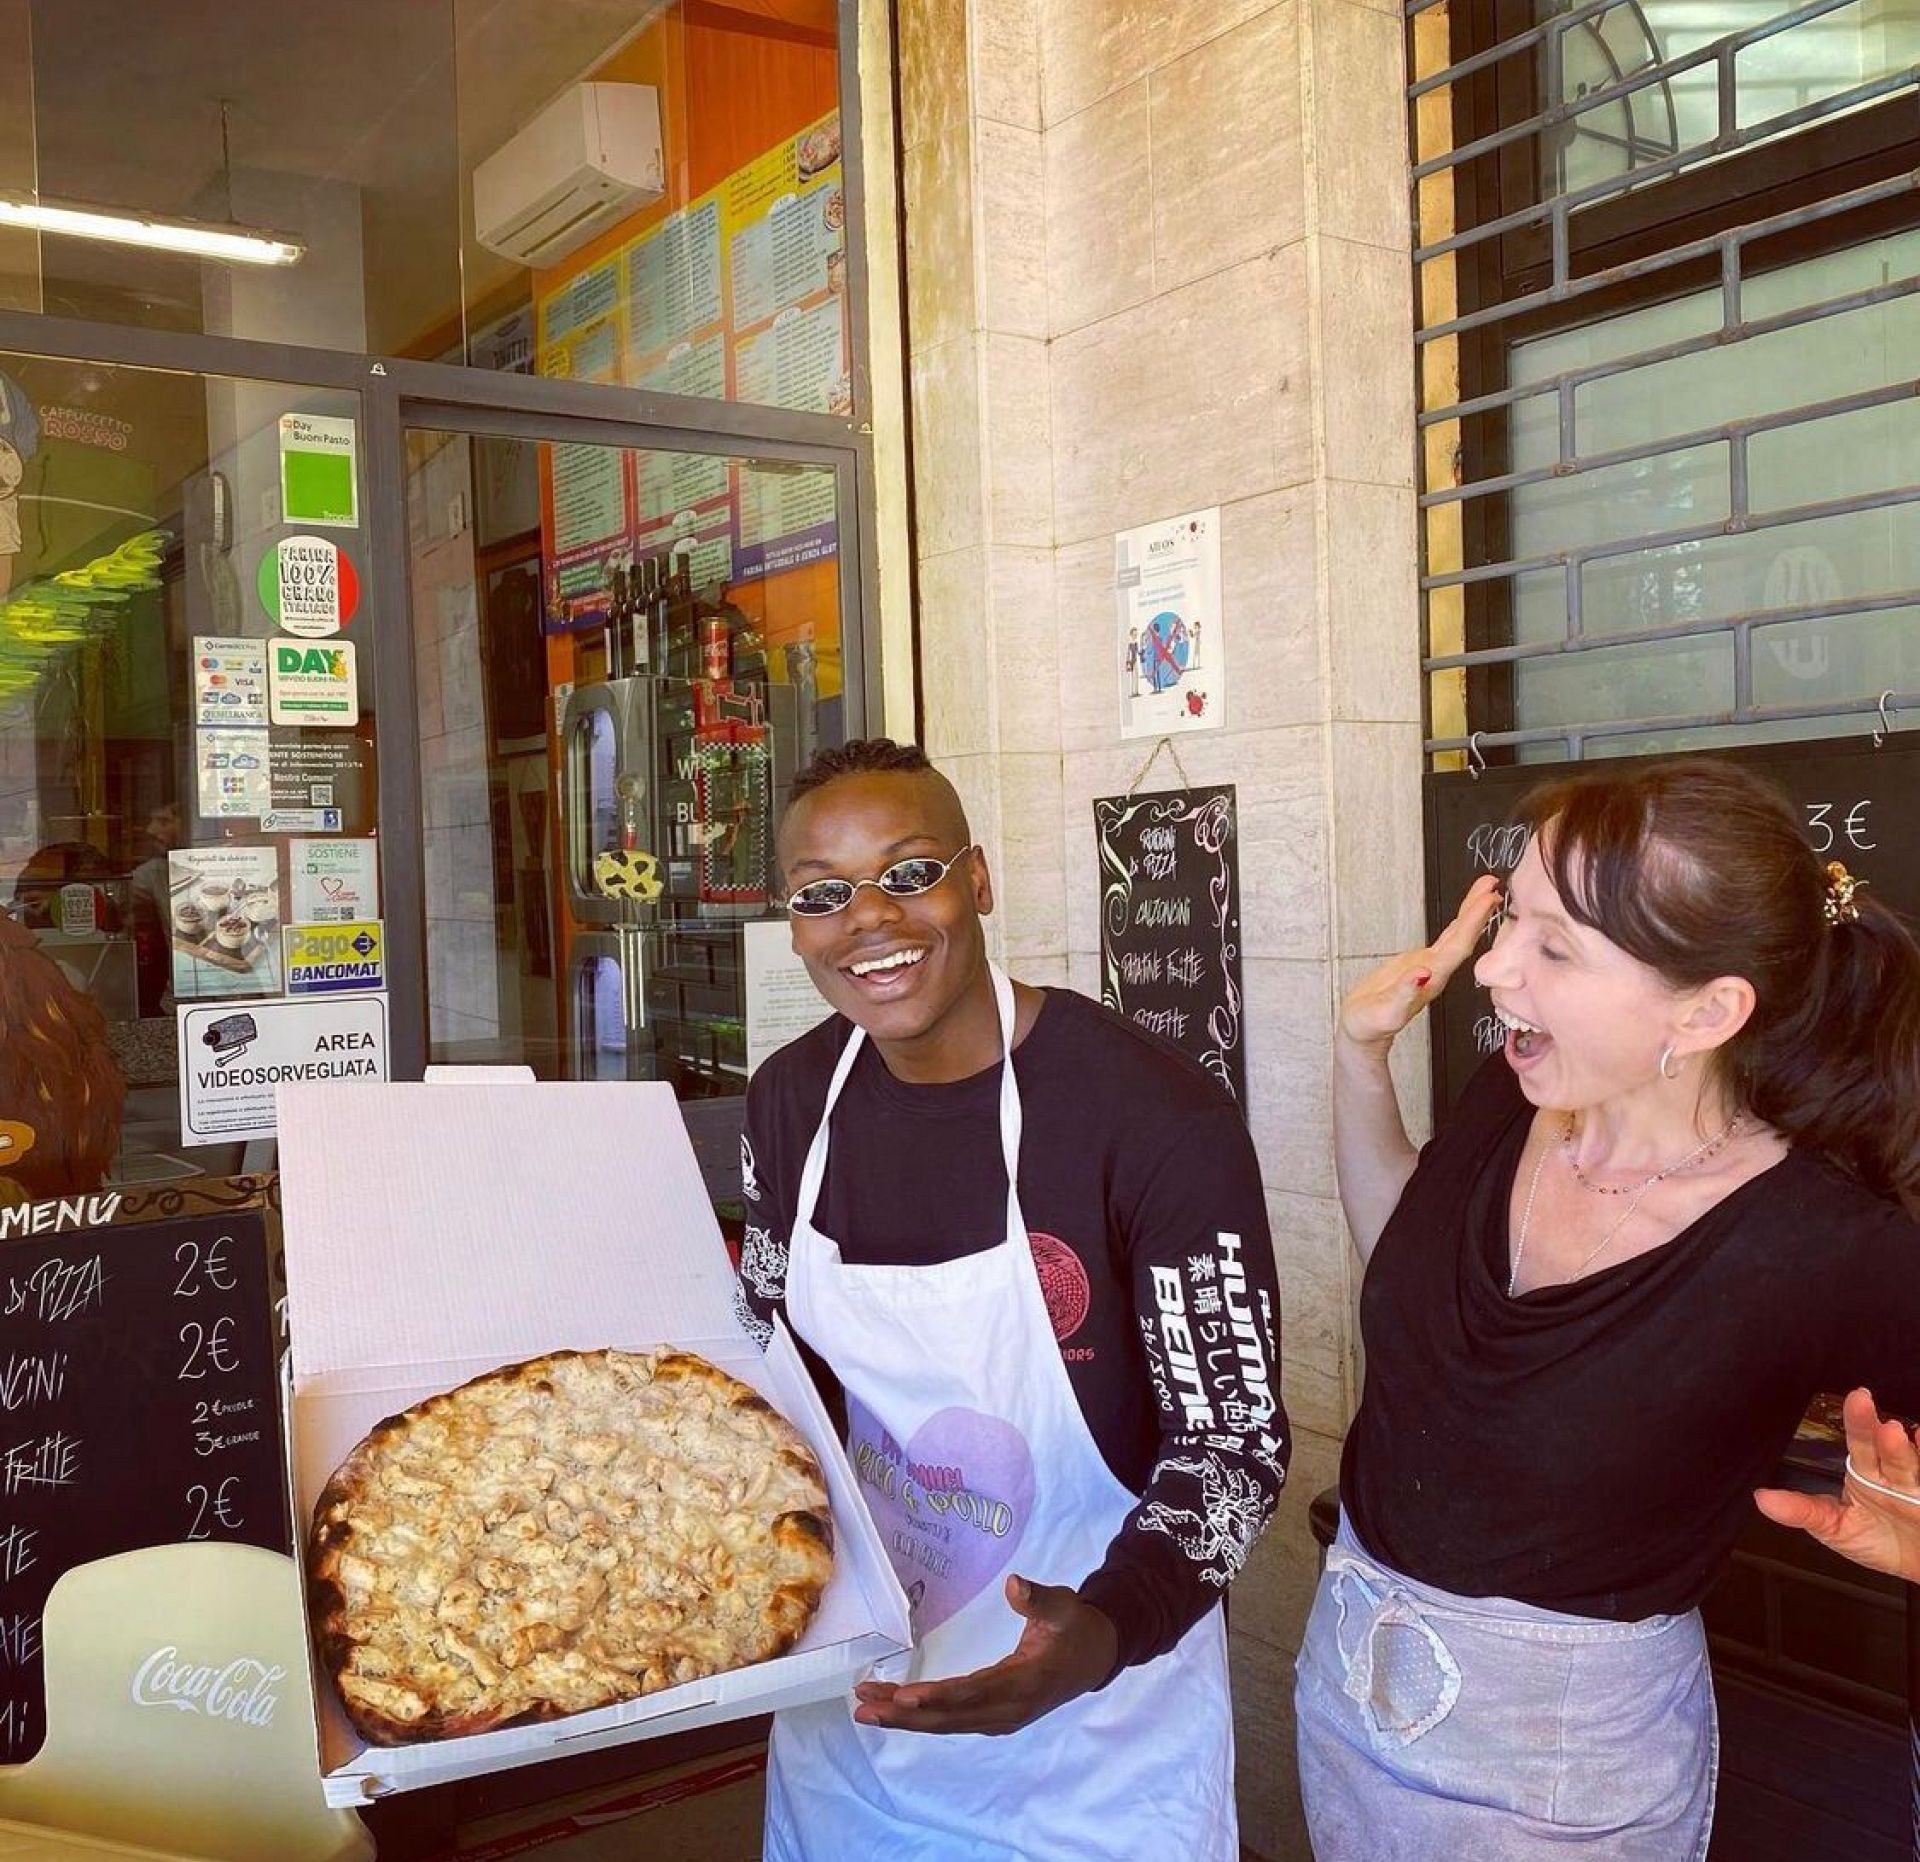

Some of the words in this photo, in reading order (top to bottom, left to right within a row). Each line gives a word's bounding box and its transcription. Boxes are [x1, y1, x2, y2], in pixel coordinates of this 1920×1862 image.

[293, 419, 312, 431] Day
[280, 562, 335, 585] 100%
[277, 647, 345, 675] DAY
[307, 848, 360, 858] SOSTIENE
[288, 931, 349, 961] Pago
[291, 961, 380, 982] BANCOMAT
[314, 1031, 376, 1053] AREA
[197, 1058, 378, 1090] VIDEOSORVEGLIATA
